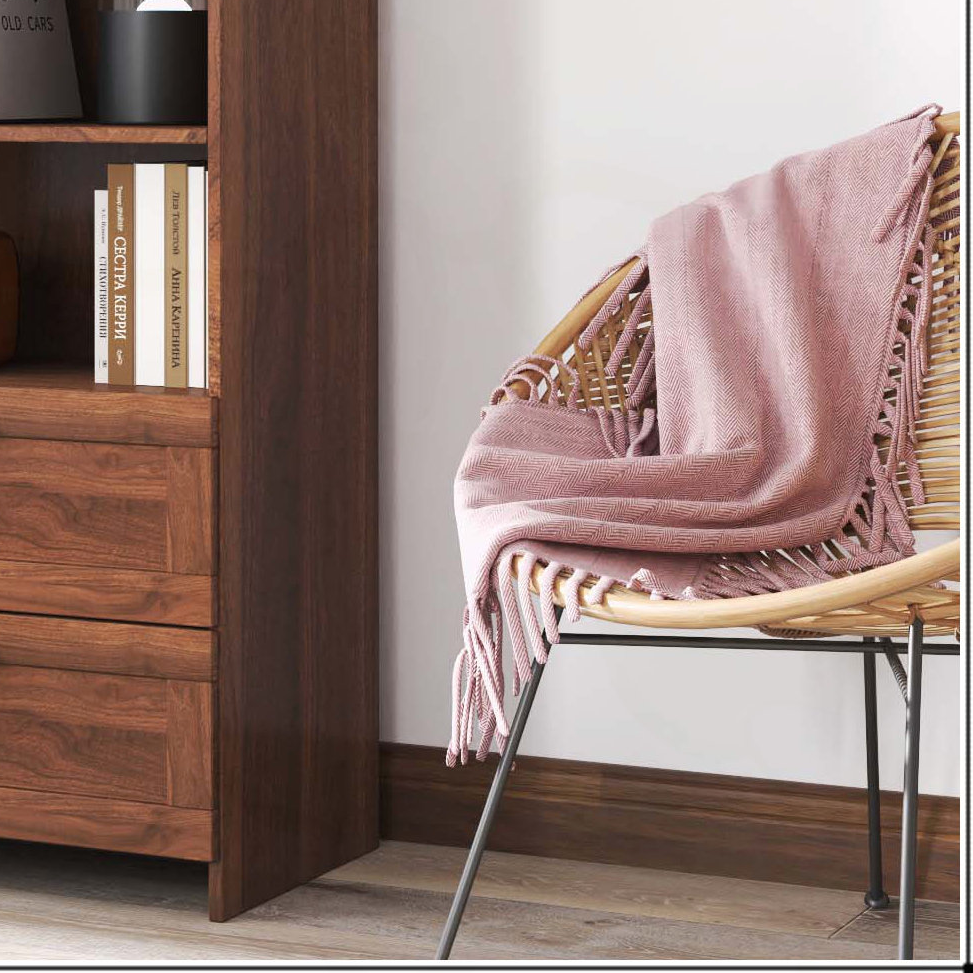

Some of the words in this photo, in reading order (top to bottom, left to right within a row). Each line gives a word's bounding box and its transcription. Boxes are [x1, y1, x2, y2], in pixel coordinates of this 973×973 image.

[1, 15, 22, 31] OLD
[27, 16, 54, 32] CARS
[114, 236, 127, 290] СЕСТРА
[114, 295, 127, 340] КЕРРИ
